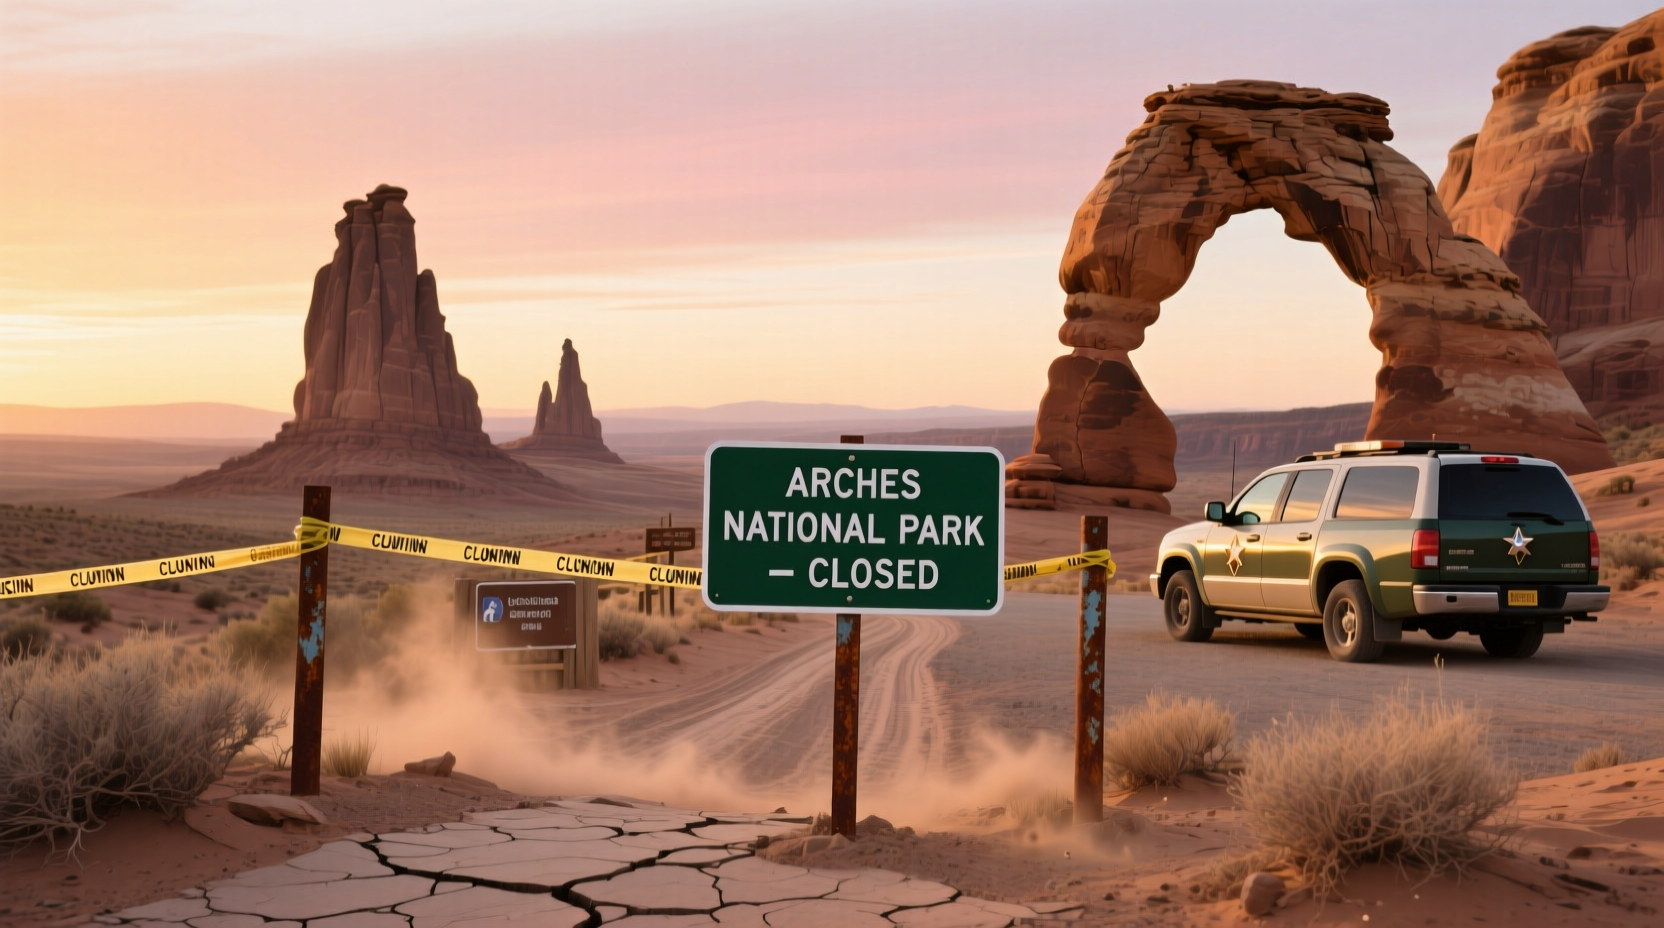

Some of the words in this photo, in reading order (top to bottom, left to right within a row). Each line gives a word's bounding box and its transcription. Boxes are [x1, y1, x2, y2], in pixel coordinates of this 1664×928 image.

[785, 466, 921, 500] ARCHES
[723, 510, 886, 545] NATIONAL
[899, 514, 985, 546] PARK
[808, 557, 939, 590] CLOSED
